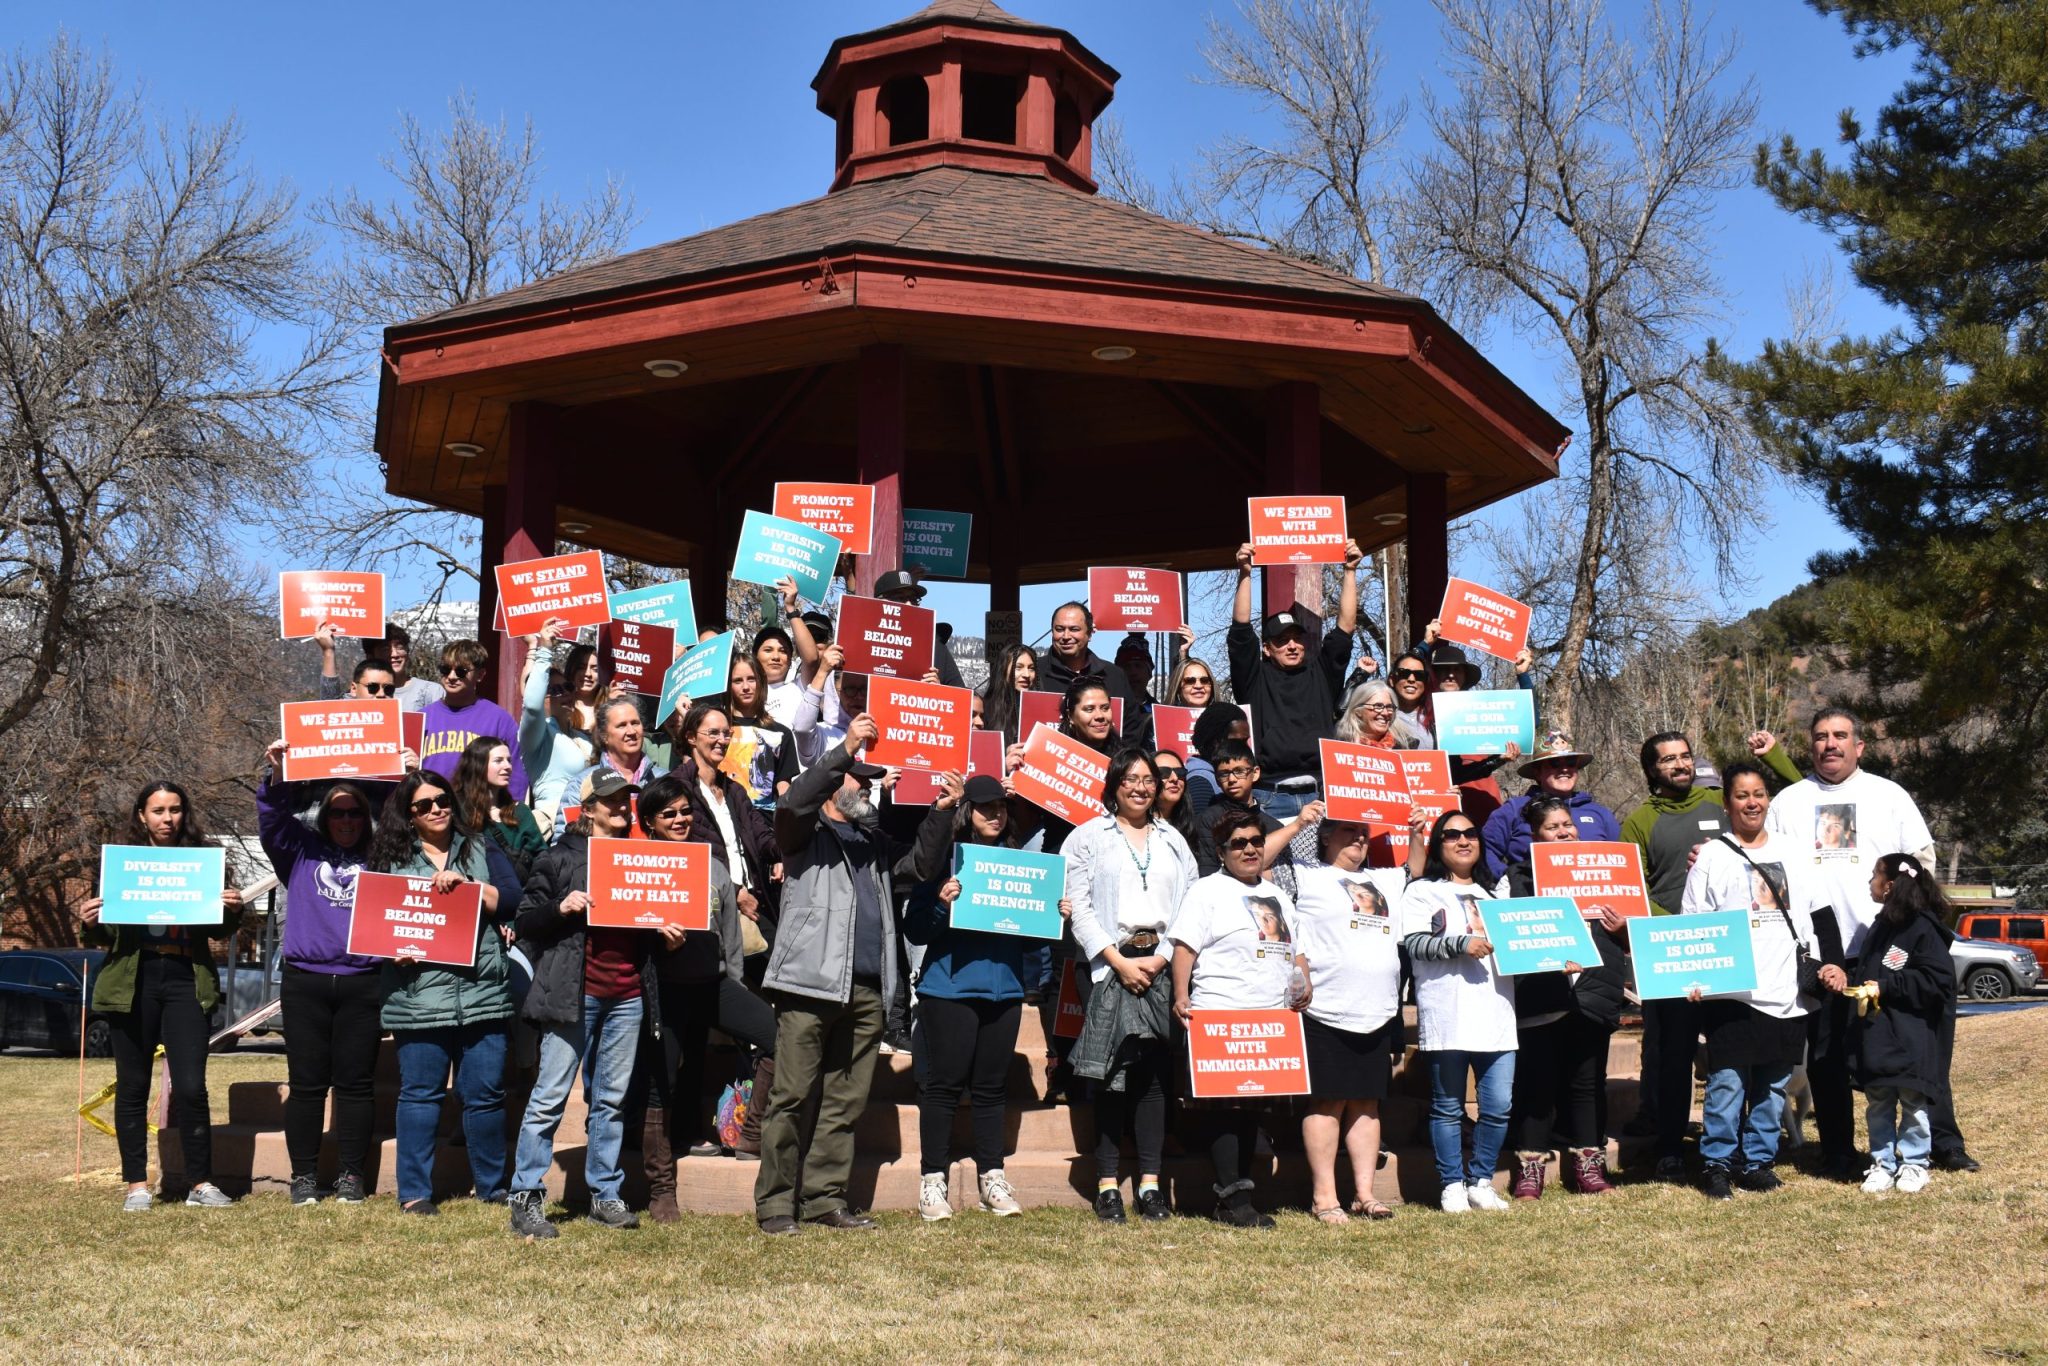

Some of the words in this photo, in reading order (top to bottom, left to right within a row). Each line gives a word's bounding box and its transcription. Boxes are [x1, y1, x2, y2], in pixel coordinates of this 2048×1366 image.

[792, 495, 854, 506] PROMOTE
[801, 508, 844, 521] UNITY,
[1264, 507, 1285, 518] WE
[1288, 506, 1332, 518] STAND
[819, 523, 854, 533] HATE
[1282, 520, 1316, 531] WITH
[761, 526, 826, 554] DIVERSITY
[904, 533, 916, 542] IS
[918, 534, 942, 543] OUR
[1255, 534, 1343, 546] IMMIGRANTS
[771, 542, 785, 553] IS
[787, 544, 812, 562] OUR
[754, 552, 819, 580] STRENGTH
[511, 572, 534, 585] WE
[536, 564, 588, 582] STAND
[1127, 570, 1146, 579] WE
[302, 582, 365, 593] PROMOTE
[531, 582, 570, 597] WITH
[1126, 582, 1148, 591] ALL
[508, 592, 603, 617] IMMIGRANTS
[616, 594, 675, 614] DIVERSITY
[1114, 594, 1160, 603] BELONG
[1464, 592, 1516, 618] PROMOTE
[300, 607, 328, 617] NOT
[331, 608, 367, 618] HATE
[642, 609, 665, 621] OUR
[882, 604, 901, 616] WE
[1122, 606, 1152, 615] HERE
[1470, 606, 1506, 628] UNITY,
[623, 623, 639, 635] WE
[878, 618, 901, 631] ALL
[1456, 615, 1481, 630] NOT
[1482, 624, 1514, 642] HATE
[620, 637, 640, 648] ALL
[864, 630, 912, 647] BELONG
[611, 648, 650, 664] BELONG
[871, 646, 903, 659] HERE
[615, 663, 642, 676] HERE
[672, 645, 718, 680] DIVERSITY
[684, 661, 704, 675] OUR
[667, 667, 713, 702] STRENGTH
[890, 693, 954, 713] PROMOTE
[300, 714, 325, 726] WE
[328, 712, 384, 726] STAND
[900, 712, 944, 731] UNITY,
[321, 728, 364, 740] WITH
[1454, 725, 1519, 734] STRENGTH
[886, 728, 915, 742] NOT
[918, 733, 954, 747] HATE
[289, 742, 397, 759] IMMIGRANTS
[1044, 740, 1068, 759] WE
[1066, 753, 1108, 782] STAN
[1334, 753, 1355, 766] WE
[1357, 756, 1396, 774] STAND
[1055, 763, 1092, 790] WITH
[1352, 771, 1386, 785] WITH
[1328, 785, 1411, 804] IMMIGRANTS
[1386, 835, 1410, 845] NOT
[124, 860, 203, 872] DIVERSITY
[613, 854, 688, 869] PROMOTE
[1550, 855, 1574, 866] WE
[1577, 854, 1627, 867] STAND
[975, 862, 1048, 880] DIVERSITY
[1570, 870, 1612, 881] WITH
[138, 876, 153, 886] IS
[156, 876, 186, 887] OUR
[407, 879, 432, 892] WE
[625, 871, 676, 888] UNITY,
[988, 879, 1002, 890] IS
[1005, 880, 1032, 894] OUR
[121, 890, 202, 900] STRENGTH
[318, 888, 354, 899] LATINO
[611, 888, 643, 901] NOT
[646, 890, 689, 903] HATE
[1542, 886, 1641, 897] IMMIGRANTS
[402, 895, 432, 908] ALL
[972, 893, 1046, 912] STRENGTH
[384, 909, 446, 926] BELONG
[1498, 909, 1564, 923] DIVERSITY
[393, 926, 434, 940] HERE
[1516, 925, 1530, 936] IS
[1532, 924, 1558, 935] OUR
[1649, 925, 1729, 943] DIVERSITY
[1508, 936, 1576, 950] STRENGTH
[1666, 945, 1681, 957] IS
[1684, 943, 1716, 956] OUR
[1653, 956, 1734, 974] STRENGTH
[1204, 1024, 1228, 1036] WE
[1231, 1022, 1285, 1038] STAND
[1225, 1041, 1267, 1054] WITH
[1196, 1057, 1301, 1072] IMMIGRANTS
